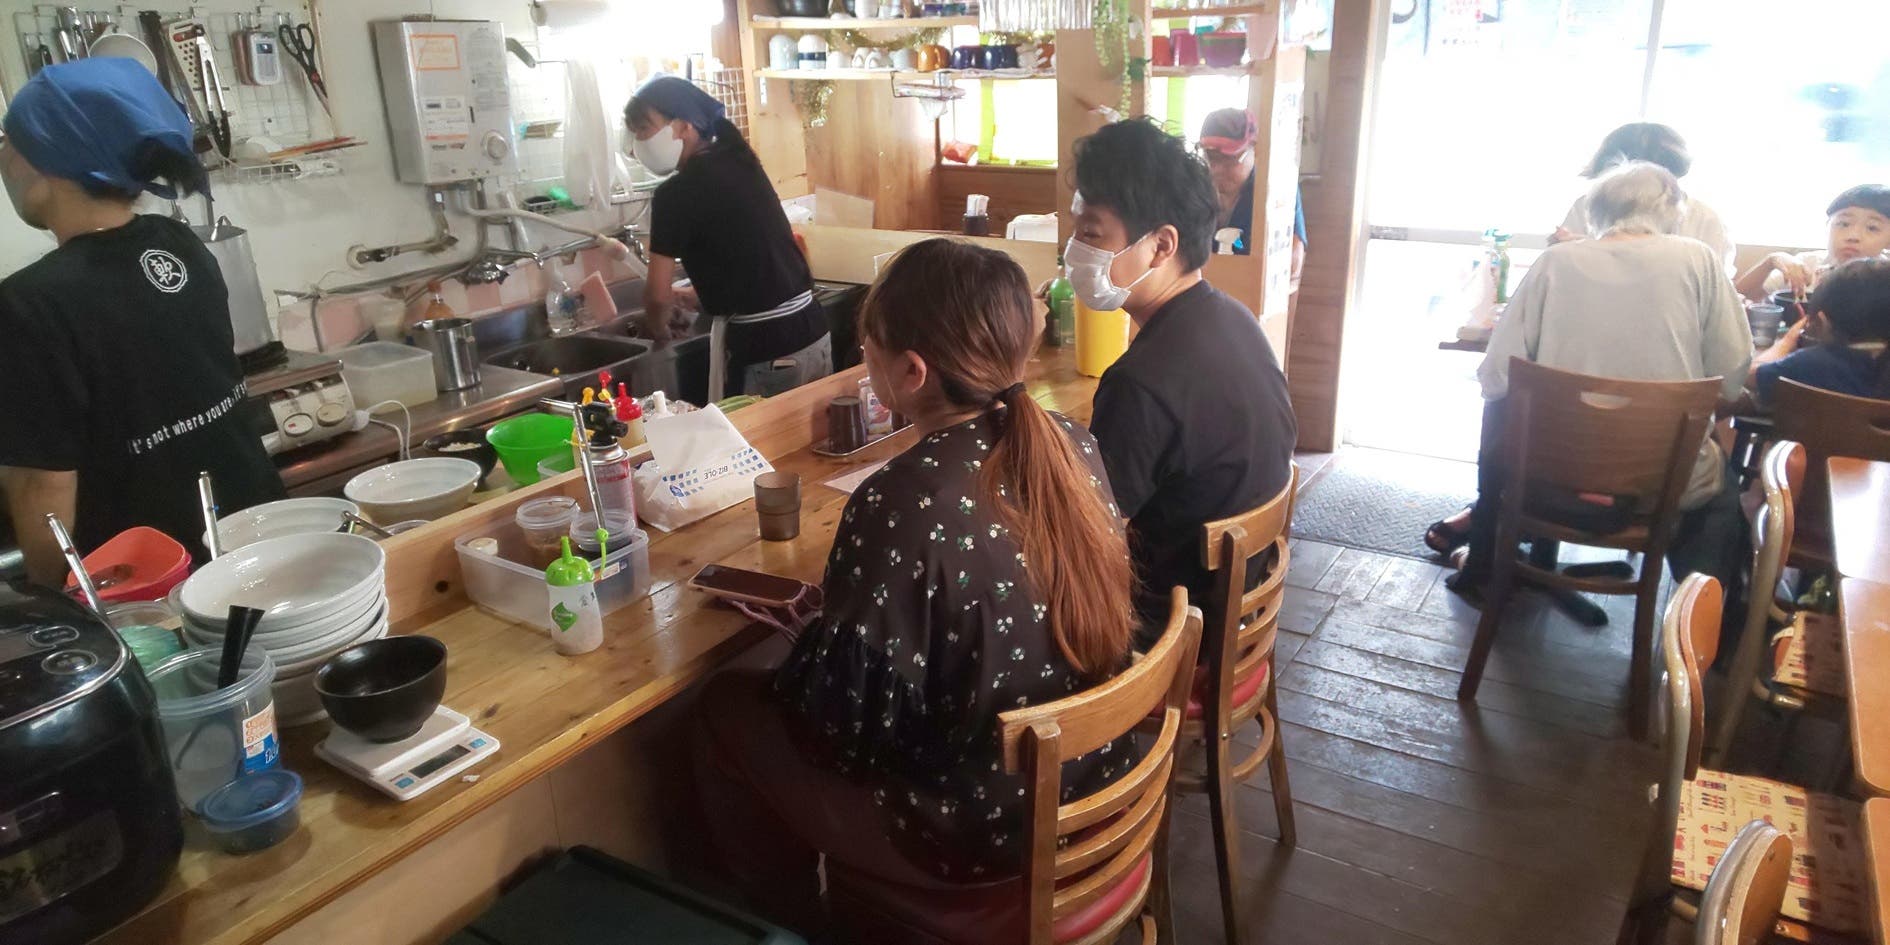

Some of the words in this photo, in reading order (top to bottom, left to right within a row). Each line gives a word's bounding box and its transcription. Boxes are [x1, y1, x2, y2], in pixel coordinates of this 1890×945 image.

[152, 425, 171, 445] not
[172, 413, 205, 436] where
[205, 404, 222, 423] you
